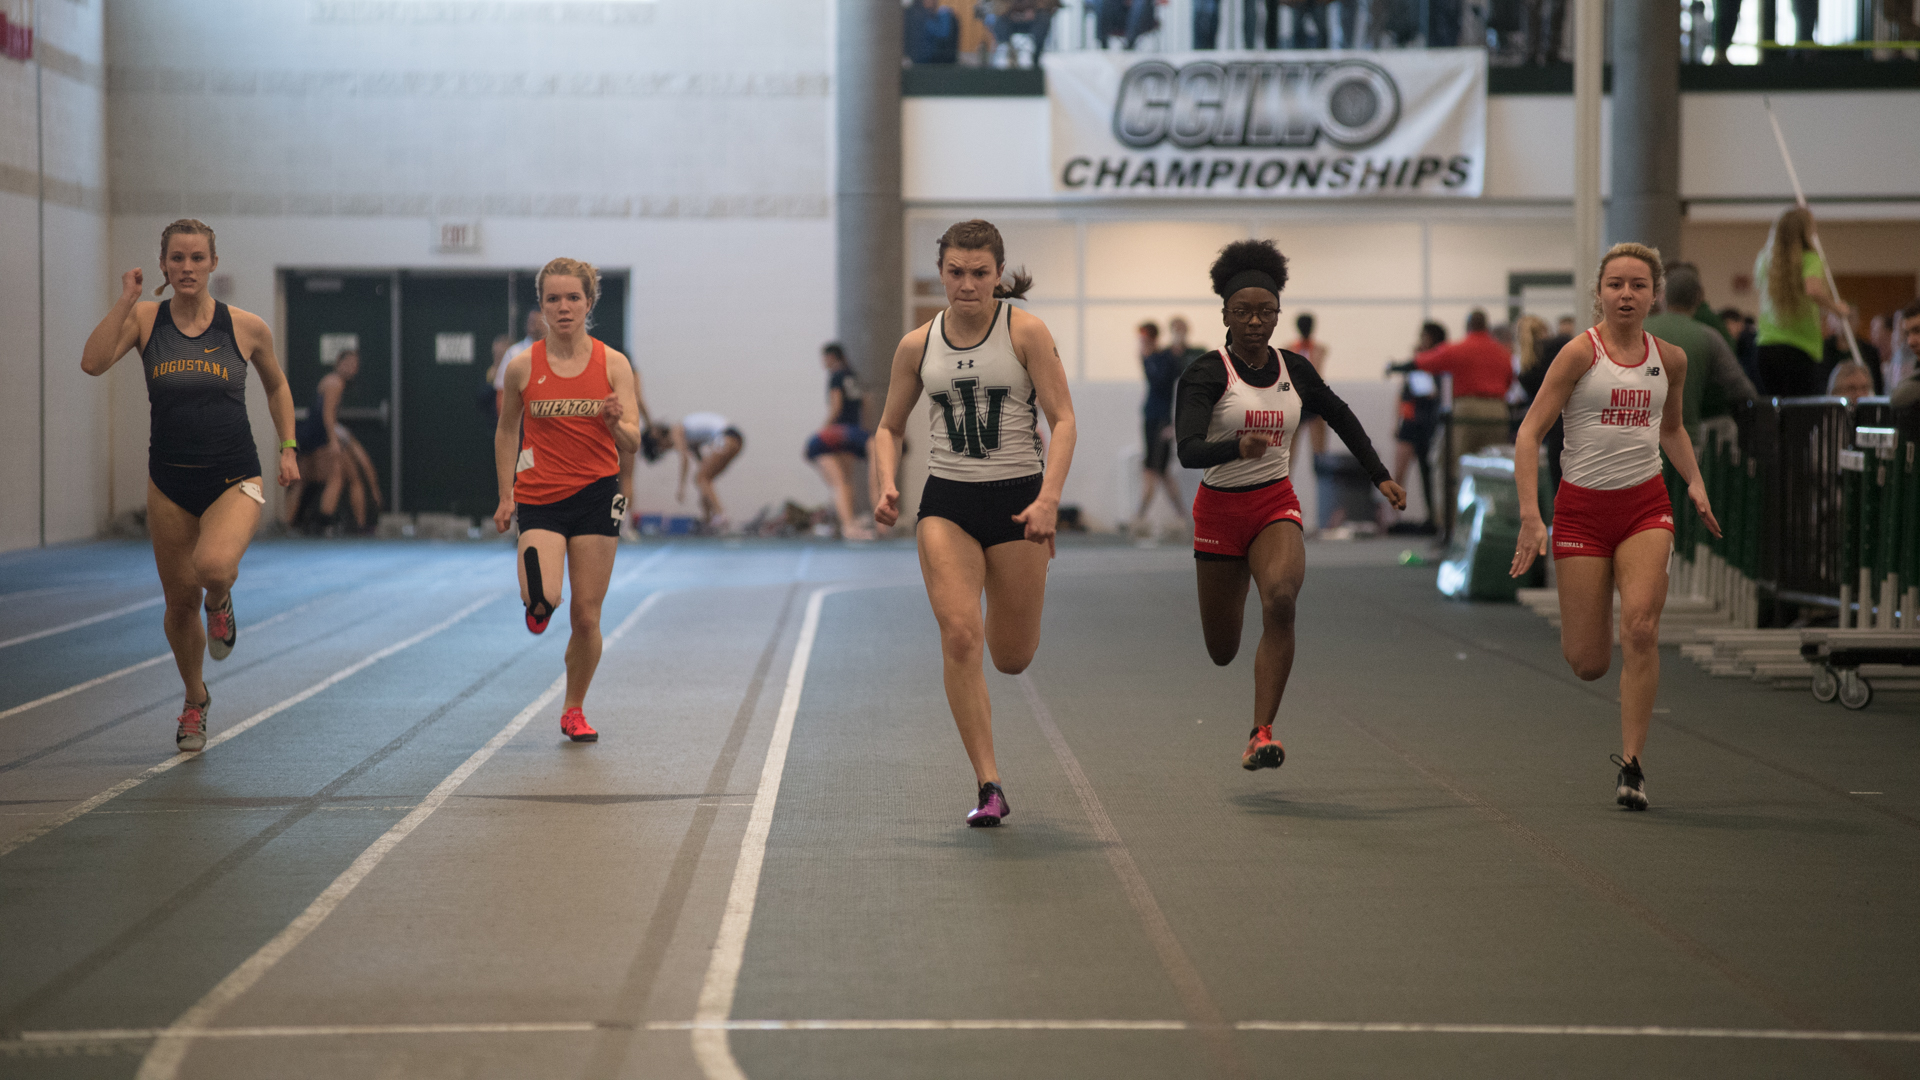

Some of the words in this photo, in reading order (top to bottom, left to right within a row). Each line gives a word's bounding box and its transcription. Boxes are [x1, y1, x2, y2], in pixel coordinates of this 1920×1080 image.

[1061, 155, 1473, 189] CHAMPIONSHIPS
[152, 360, 229, 381] AUGUSTANA
[1610, 388, 1651, 408] NORTH
[530, 399, 605, 418] WHEATON
[1244, 409, 1284, 428] NORTH
[1601, 409, 1651, 427] CENTRAL
[612, 496, 626, 516] 4
